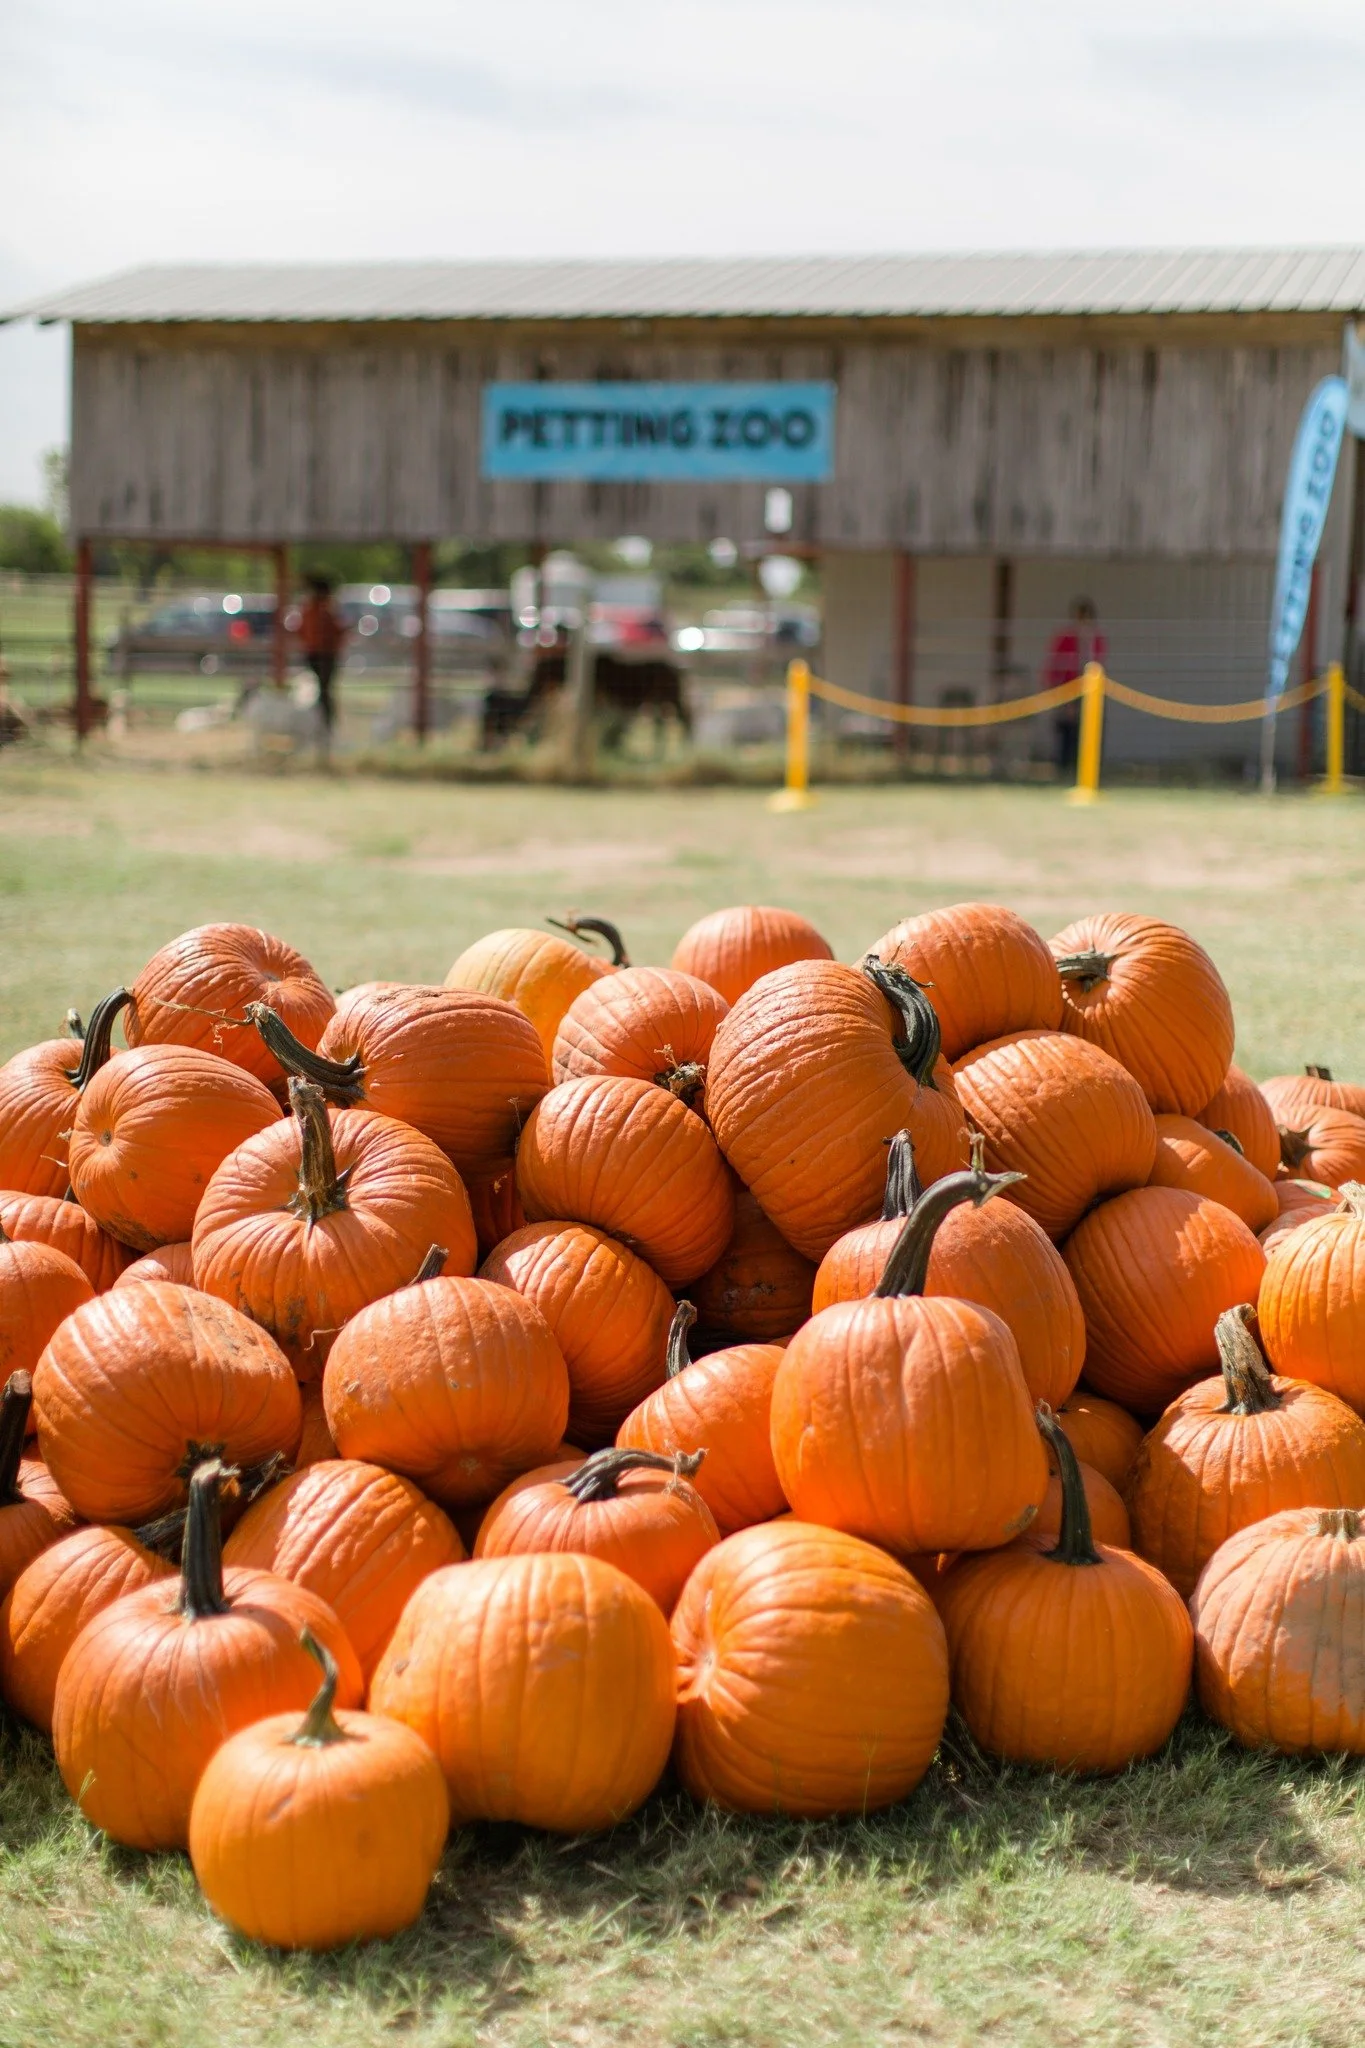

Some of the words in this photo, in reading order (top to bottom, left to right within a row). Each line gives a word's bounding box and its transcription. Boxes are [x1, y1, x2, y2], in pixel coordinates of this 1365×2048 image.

[502, 407, 694, 449] PETTING
[709, 408, 816, 449] ZOO
[1268, 513, 1314, 690] TTING
[1306, 409, 1336, 501] ZOO
